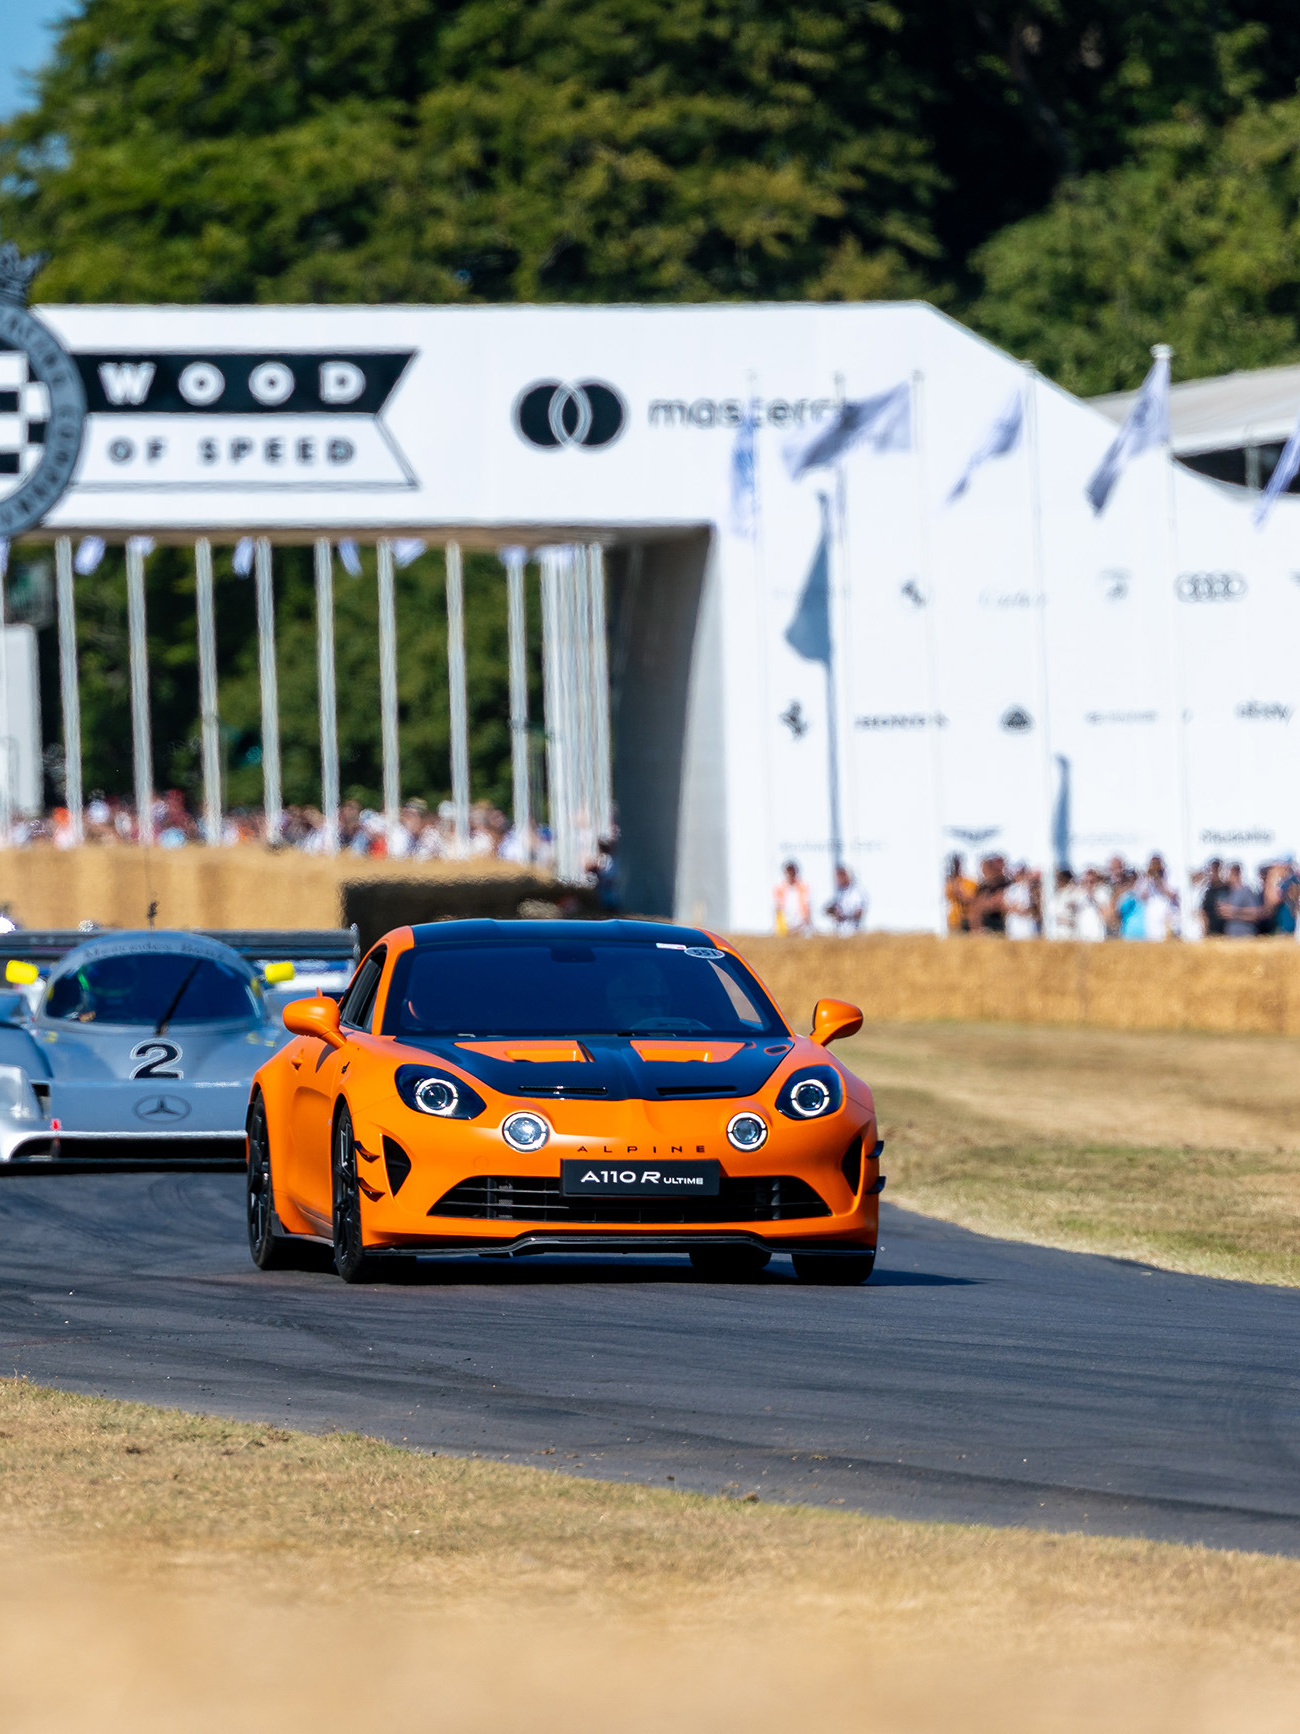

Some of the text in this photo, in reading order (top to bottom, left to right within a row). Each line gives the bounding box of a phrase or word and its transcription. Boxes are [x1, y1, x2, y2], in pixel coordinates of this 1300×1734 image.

[97, 361, 366, 406] WOOD
[106, 434, 166, 465] OF
[198, 434, 356, 465] SPEED
[130, 1038, 184, 1080] 2
[577, 1145, 705, 1154] ALPINE
[580, 1170, 704, 1185] A110 R ULTIME
